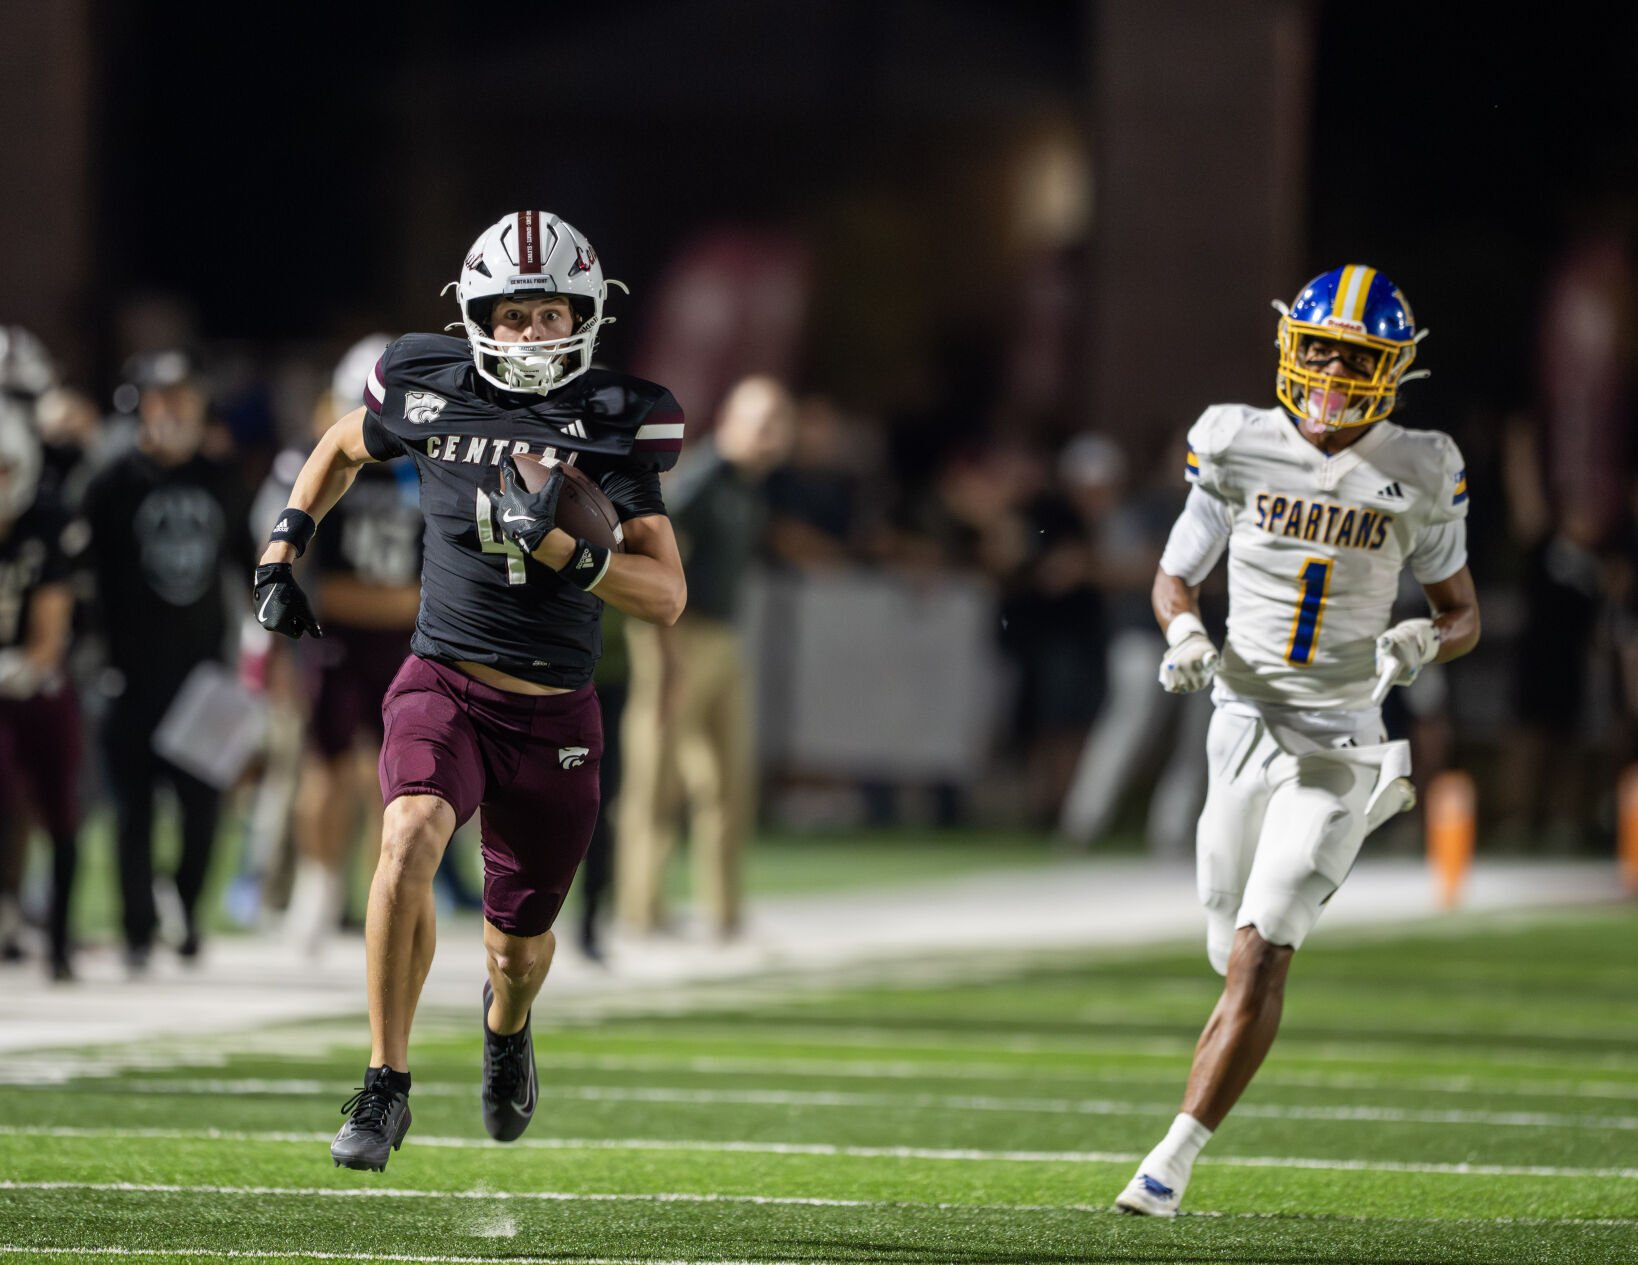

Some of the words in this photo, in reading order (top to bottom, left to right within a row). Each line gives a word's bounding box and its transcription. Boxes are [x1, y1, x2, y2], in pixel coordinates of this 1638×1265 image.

[476, 487, 527, 585] 4
[1254, 492, 1394, 552] SPARTANS
[1284, 557, 1334, 667] 1
